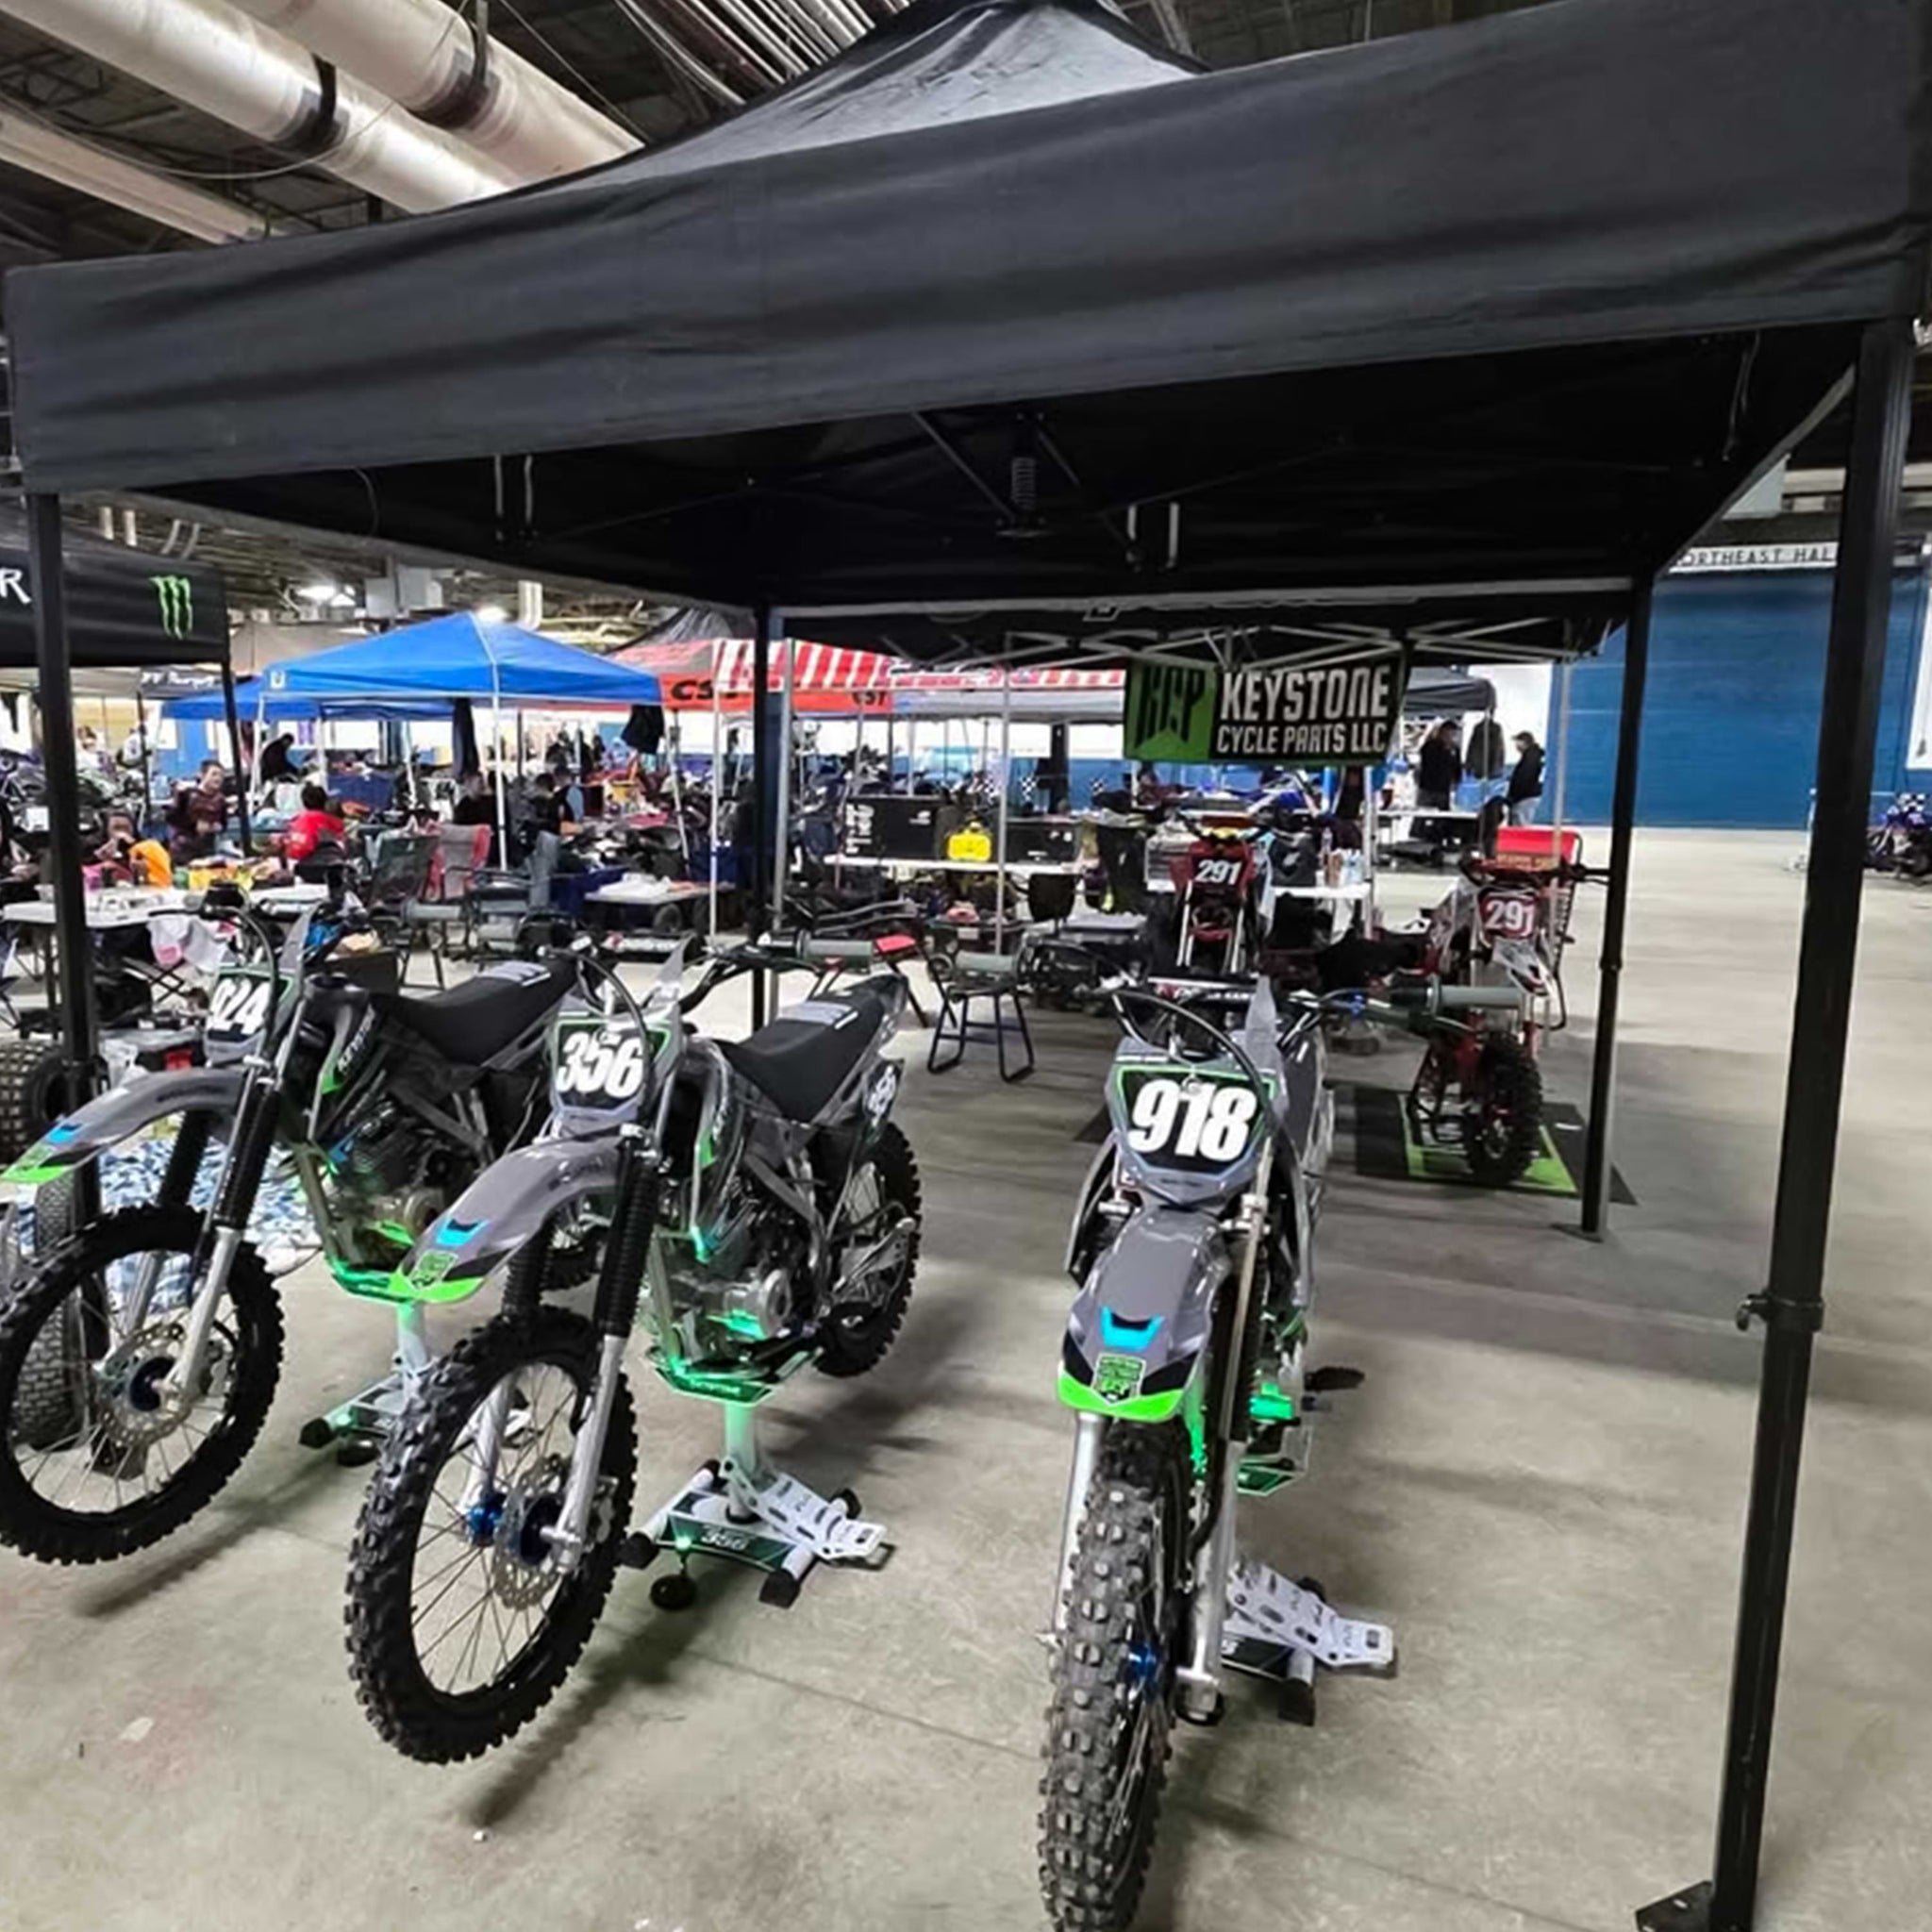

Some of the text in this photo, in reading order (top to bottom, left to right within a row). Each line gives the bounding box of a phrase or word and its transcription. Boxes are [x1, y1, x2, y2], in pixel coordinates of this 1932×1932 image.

[1679, 547, 1783, 566] ORTHEAST
[1220, 665, 1391, 723] KEYSTONE
[1217, 722, 1388, 754] CYCLE PARTS LLC
[1193, 858, 1243, 885] 291
[1484, 900, 1535, 936] 291
[555, 1031, 643, 1098] 356
[1127, 1079, 1257, 1162] 918
